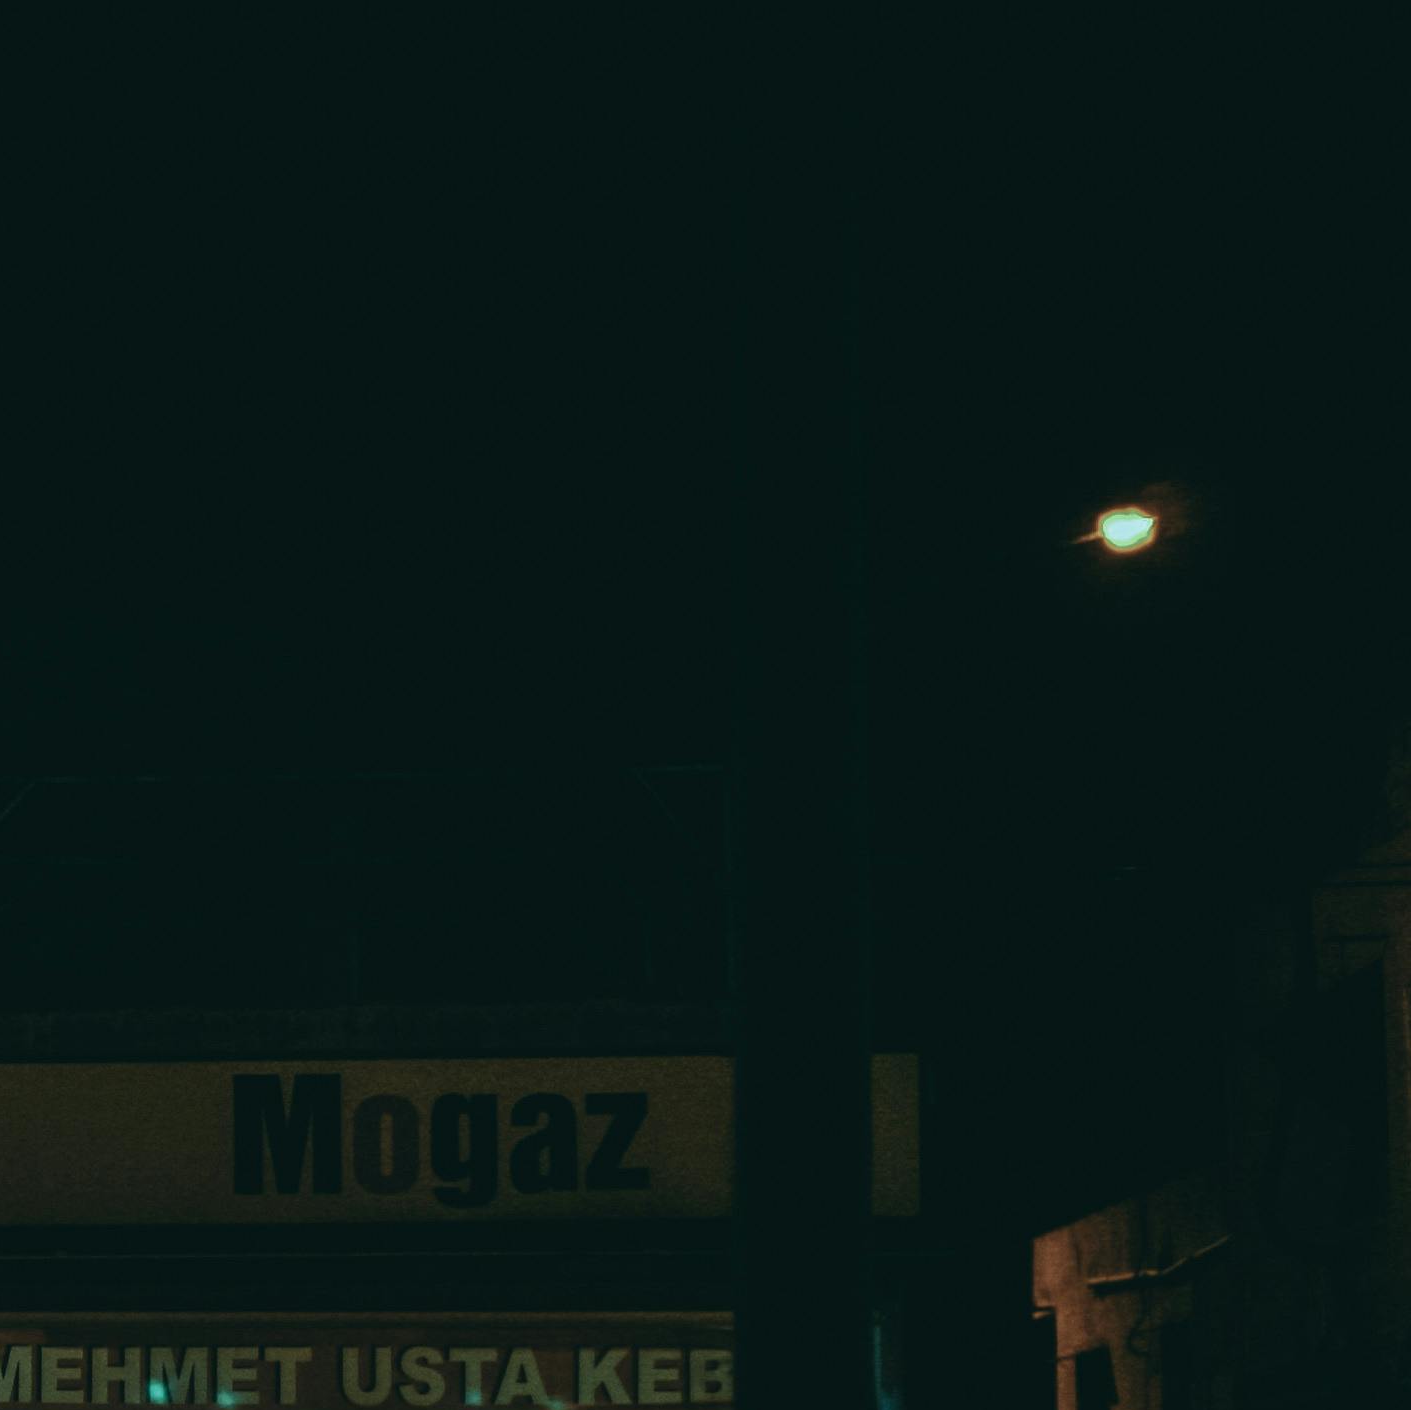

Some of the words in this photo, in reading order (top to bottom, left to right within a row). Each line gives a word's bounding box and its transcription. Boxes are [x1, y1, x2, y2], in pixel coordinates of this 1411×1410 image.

[232, 1073, 651, 1206] Mogaz
[342, 1346, 557, 1407] USTA
[577, 1348, 735, 1406] KEB
